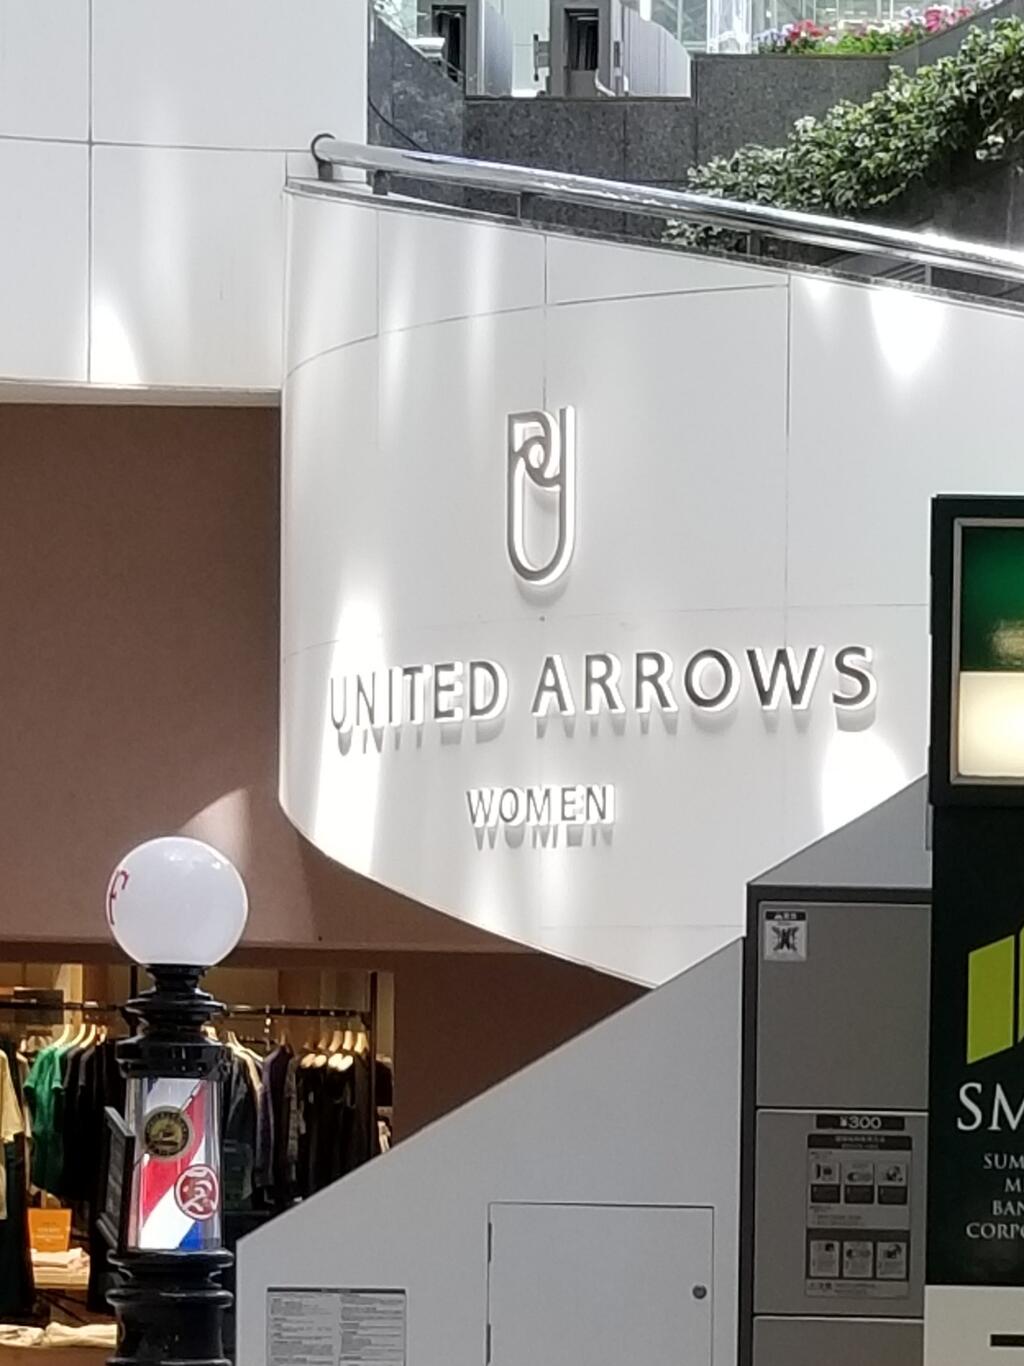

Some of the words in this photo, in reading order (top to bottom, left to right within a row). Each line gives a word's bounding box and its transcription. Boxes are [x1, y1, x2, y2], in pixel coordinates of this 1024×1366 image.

[330, 657, 508, 732] UNITED
[531, 645, 878, 714] ARROWS
[466, 785, 614, 828] WOMEN
